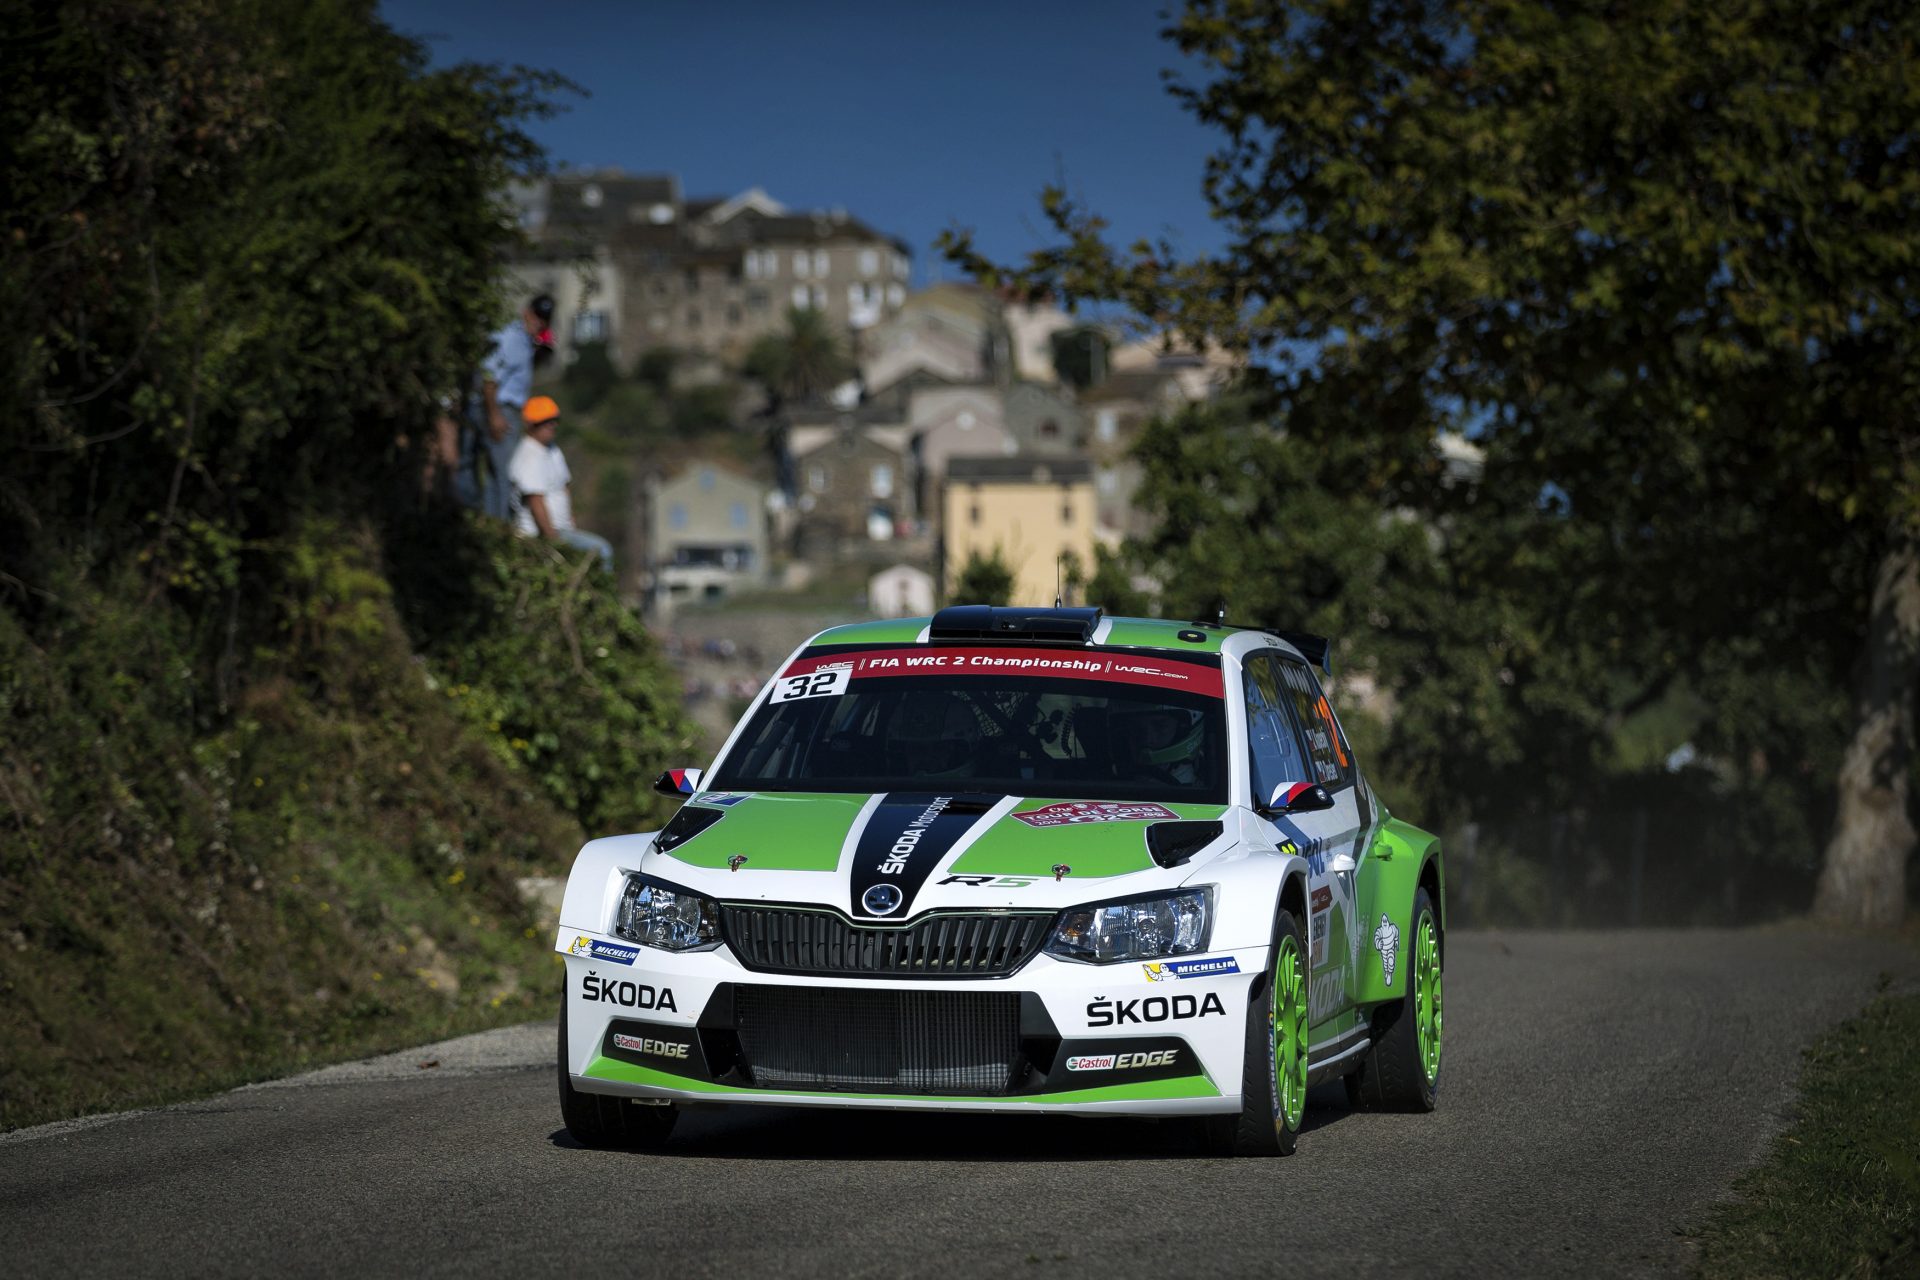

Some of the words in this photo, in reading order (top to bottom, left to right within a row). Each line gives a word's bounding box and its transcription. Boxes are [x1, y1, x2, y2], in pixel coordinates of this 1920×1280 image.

[869, 658, 900, 668] FIA
[906, 656, 948, 667] WRC
[952, 656, 967, 666] 2
[970, 656, 1102, 672] Championship
[783, 672, 838, 700] 32
[1025, 812, 1077, 821] TOUR
[1078, 809, 1103, 817] DE
[1105, 806, 1166, 815] CORSE
[877, 828, 926, 875] ŠKODA
[936, 875, 1039, 888] R5
[595, 945, 639, 960] MICHELIN
[1177, 960, 1237, 974] MICHELIN
[582, 970, 678, 1013] ŠKODA
[1309, 965, 1346, 1024] KODA
[1086, 992, 1227, 1028] ŠKODA
[620, 1036, 641, 1050] Castrol
[643, 1038, 691, 1059] EDGE
[1078, 1056, 1112, 1069] Castrol
[1115, 1049, 1180, 1069] EDGE
